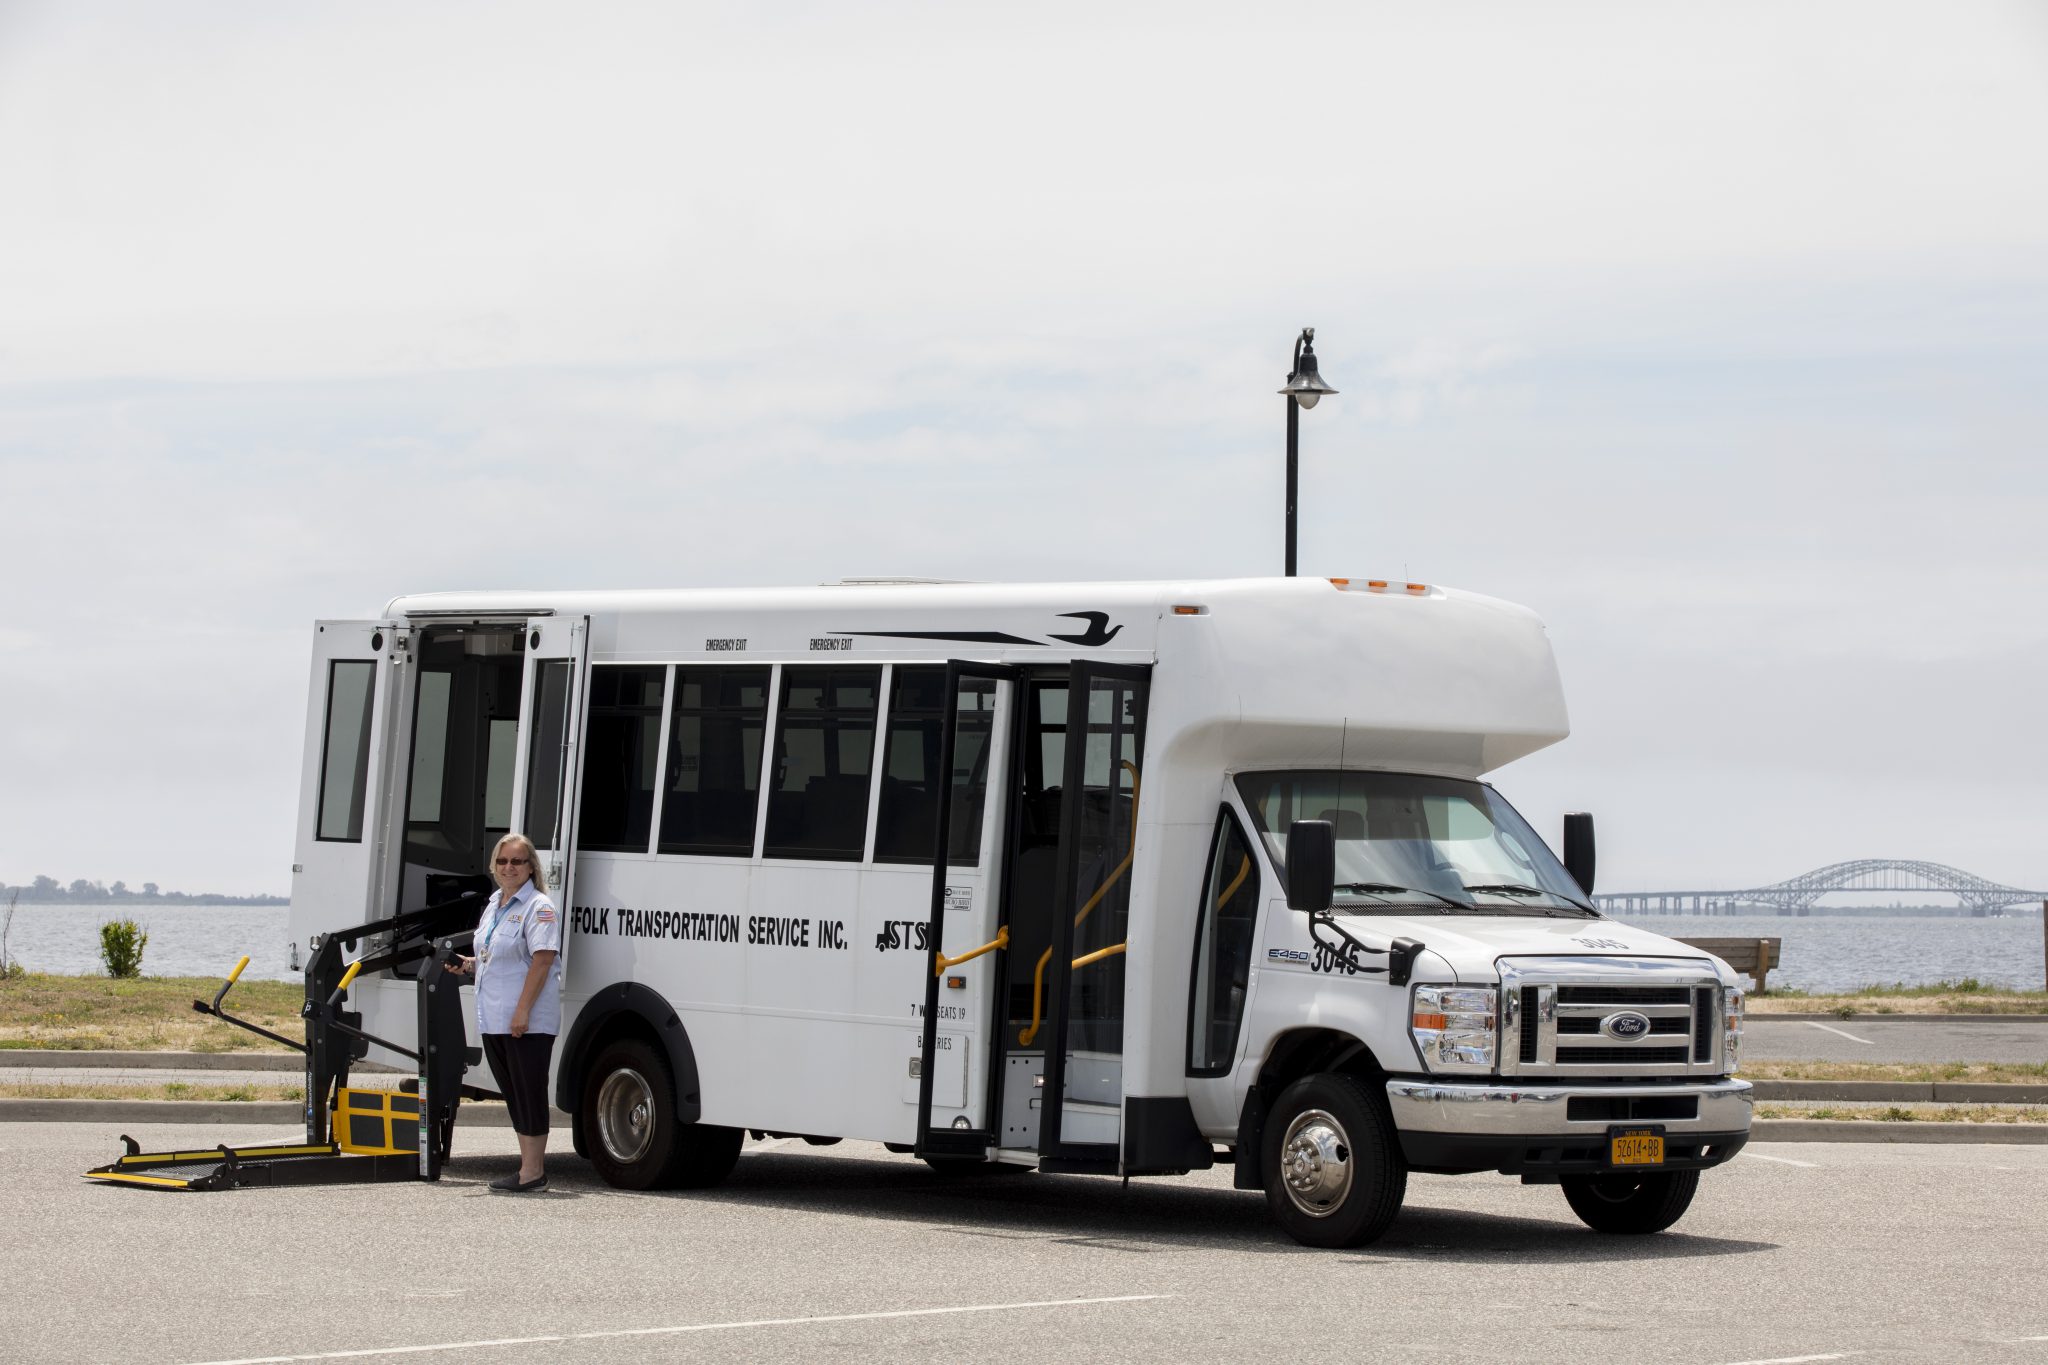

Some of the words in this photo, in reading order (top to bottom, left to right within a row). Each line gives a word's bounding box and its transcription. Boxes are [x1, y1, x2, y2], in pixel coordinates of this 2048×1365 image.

[706, 639, 735, 651] EMERGENCY
[735, 639, 747, 651] EXIT
[810, 638, 841, 650] EMERGENCY
[841, 638, 853, 650] EXIT
[571, 906, 610, 935] FOLK
[617, 908, 740, 943] TRANSPORTATION
[748, 915, 810, 947] SERVICE
[818, 919, 848, 950] INC.
[1570, 938, 1630, 950] 3045
[911, 1003, 916, 1017] 7
[958, 1007, 966, 1020] 19
[1619, 1019, 1641, 1032] Ford
[917, 1035, 952, 1050] BRIES
